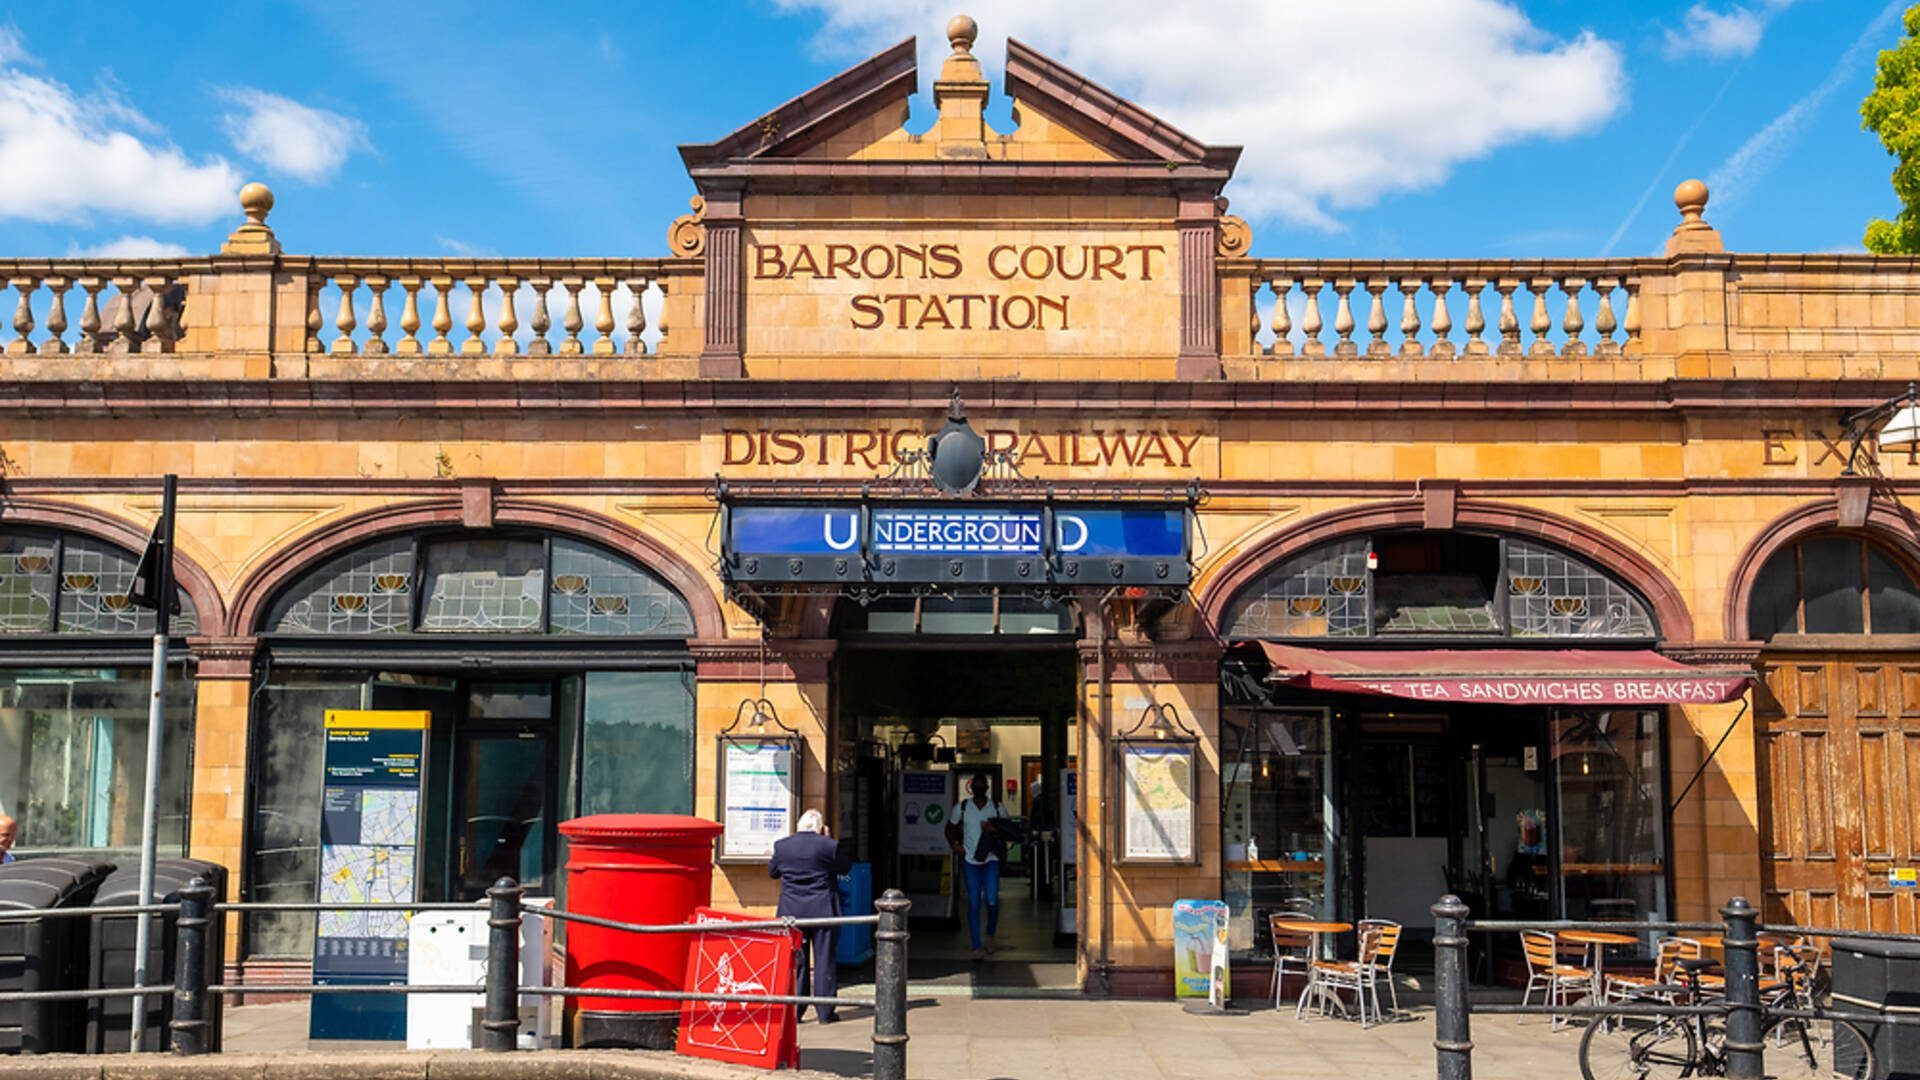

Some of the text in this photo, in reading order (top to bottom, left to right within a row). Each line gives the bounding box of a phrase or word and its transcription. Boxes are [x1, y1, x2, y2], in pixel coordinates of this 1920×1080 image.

[754, 243, 1167, 281] BARONS COURT
[850, 294, 1070, 331] STATION
[722, 428, 1201, 469] DISTRIC RAILWAY
[823, 512, 1089, 552] UNDERGROUND
[1404, 682, 1449, 698] TEA
[1459, 682, 1604, 700] SANDWICHES
[1613, 681, 1728, 701] BREAKFAST
